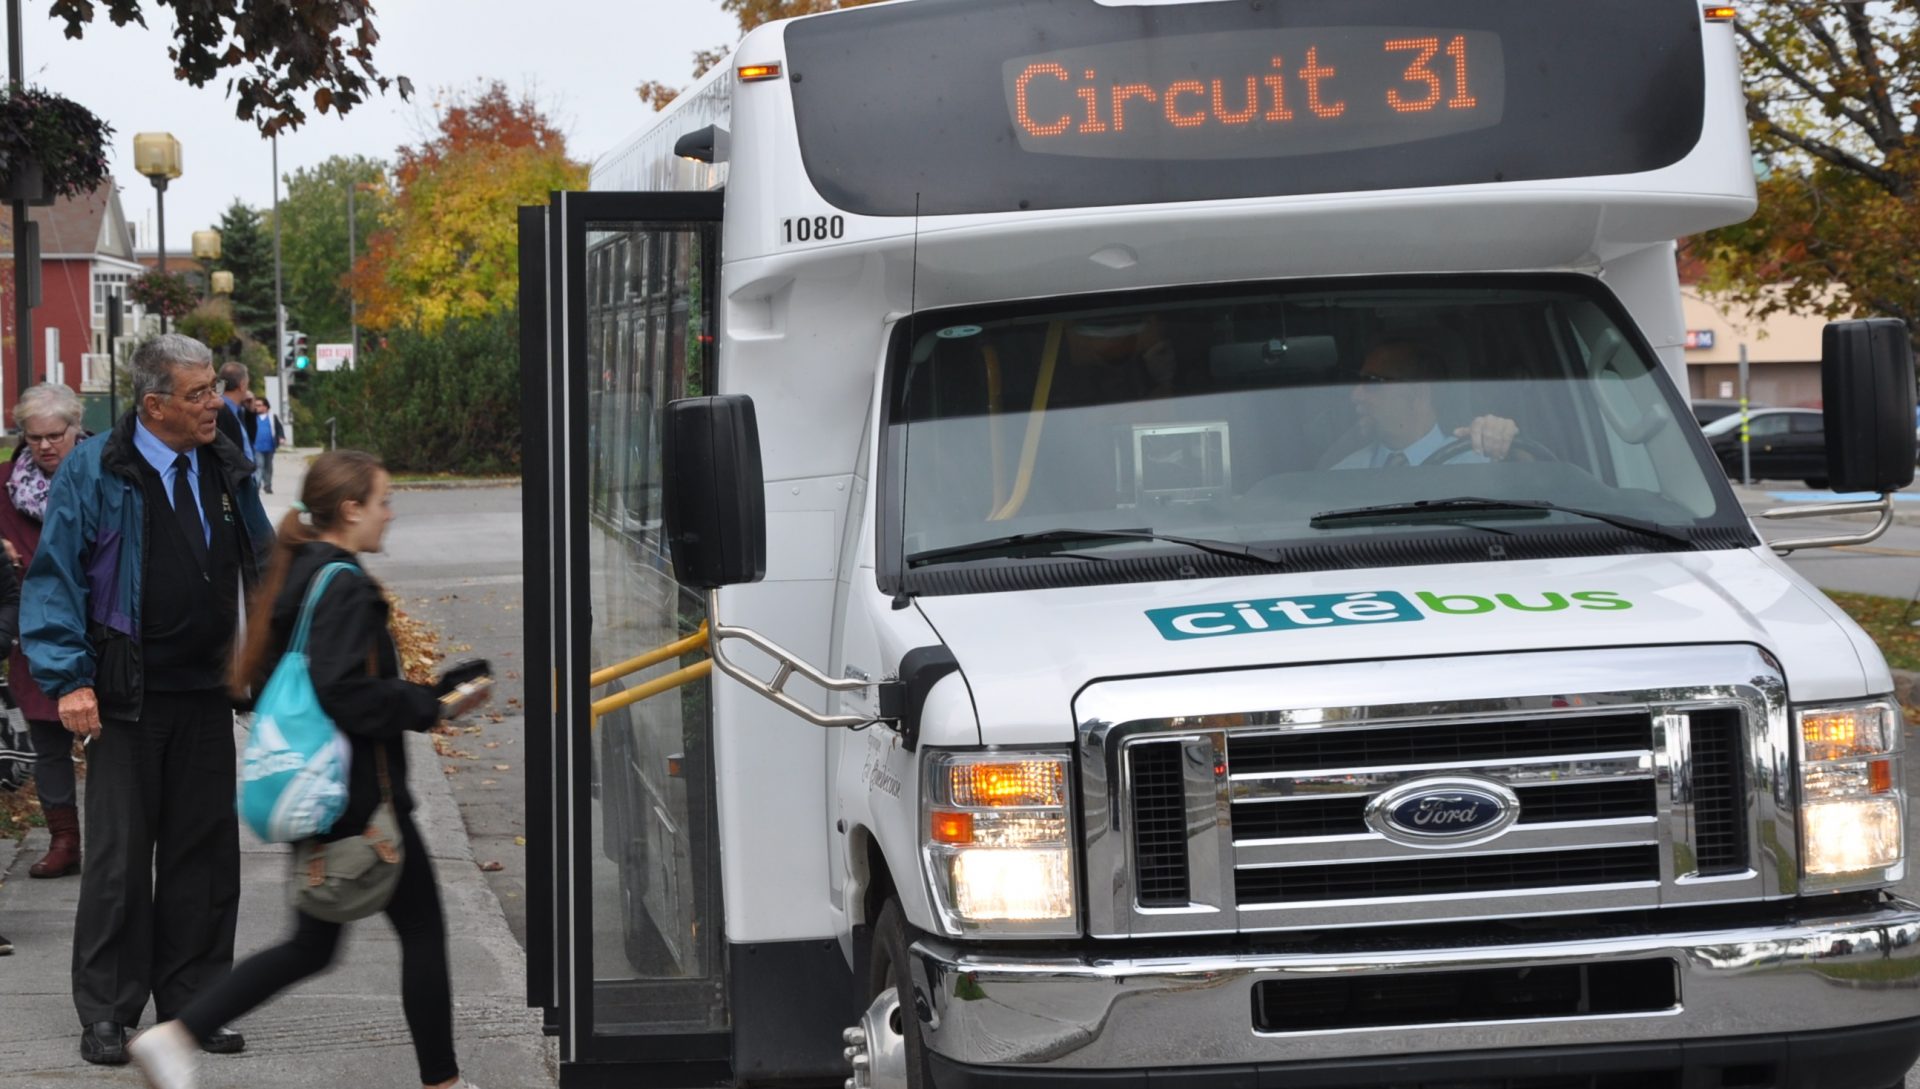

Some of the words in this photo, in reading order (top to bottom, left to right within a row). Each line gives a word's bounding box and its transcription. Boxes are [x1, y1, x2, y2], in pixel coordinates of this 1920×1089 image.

[1015, 45, 1345, 136] Circuit
[1384, 35, 1477, 113] 31
[783, 214, 844, 243] 1080
[1171, 591, 1400, 635] cité
[1414, 590, 1634, 616] bus
[1413, 796, 1480, 825] Ford
